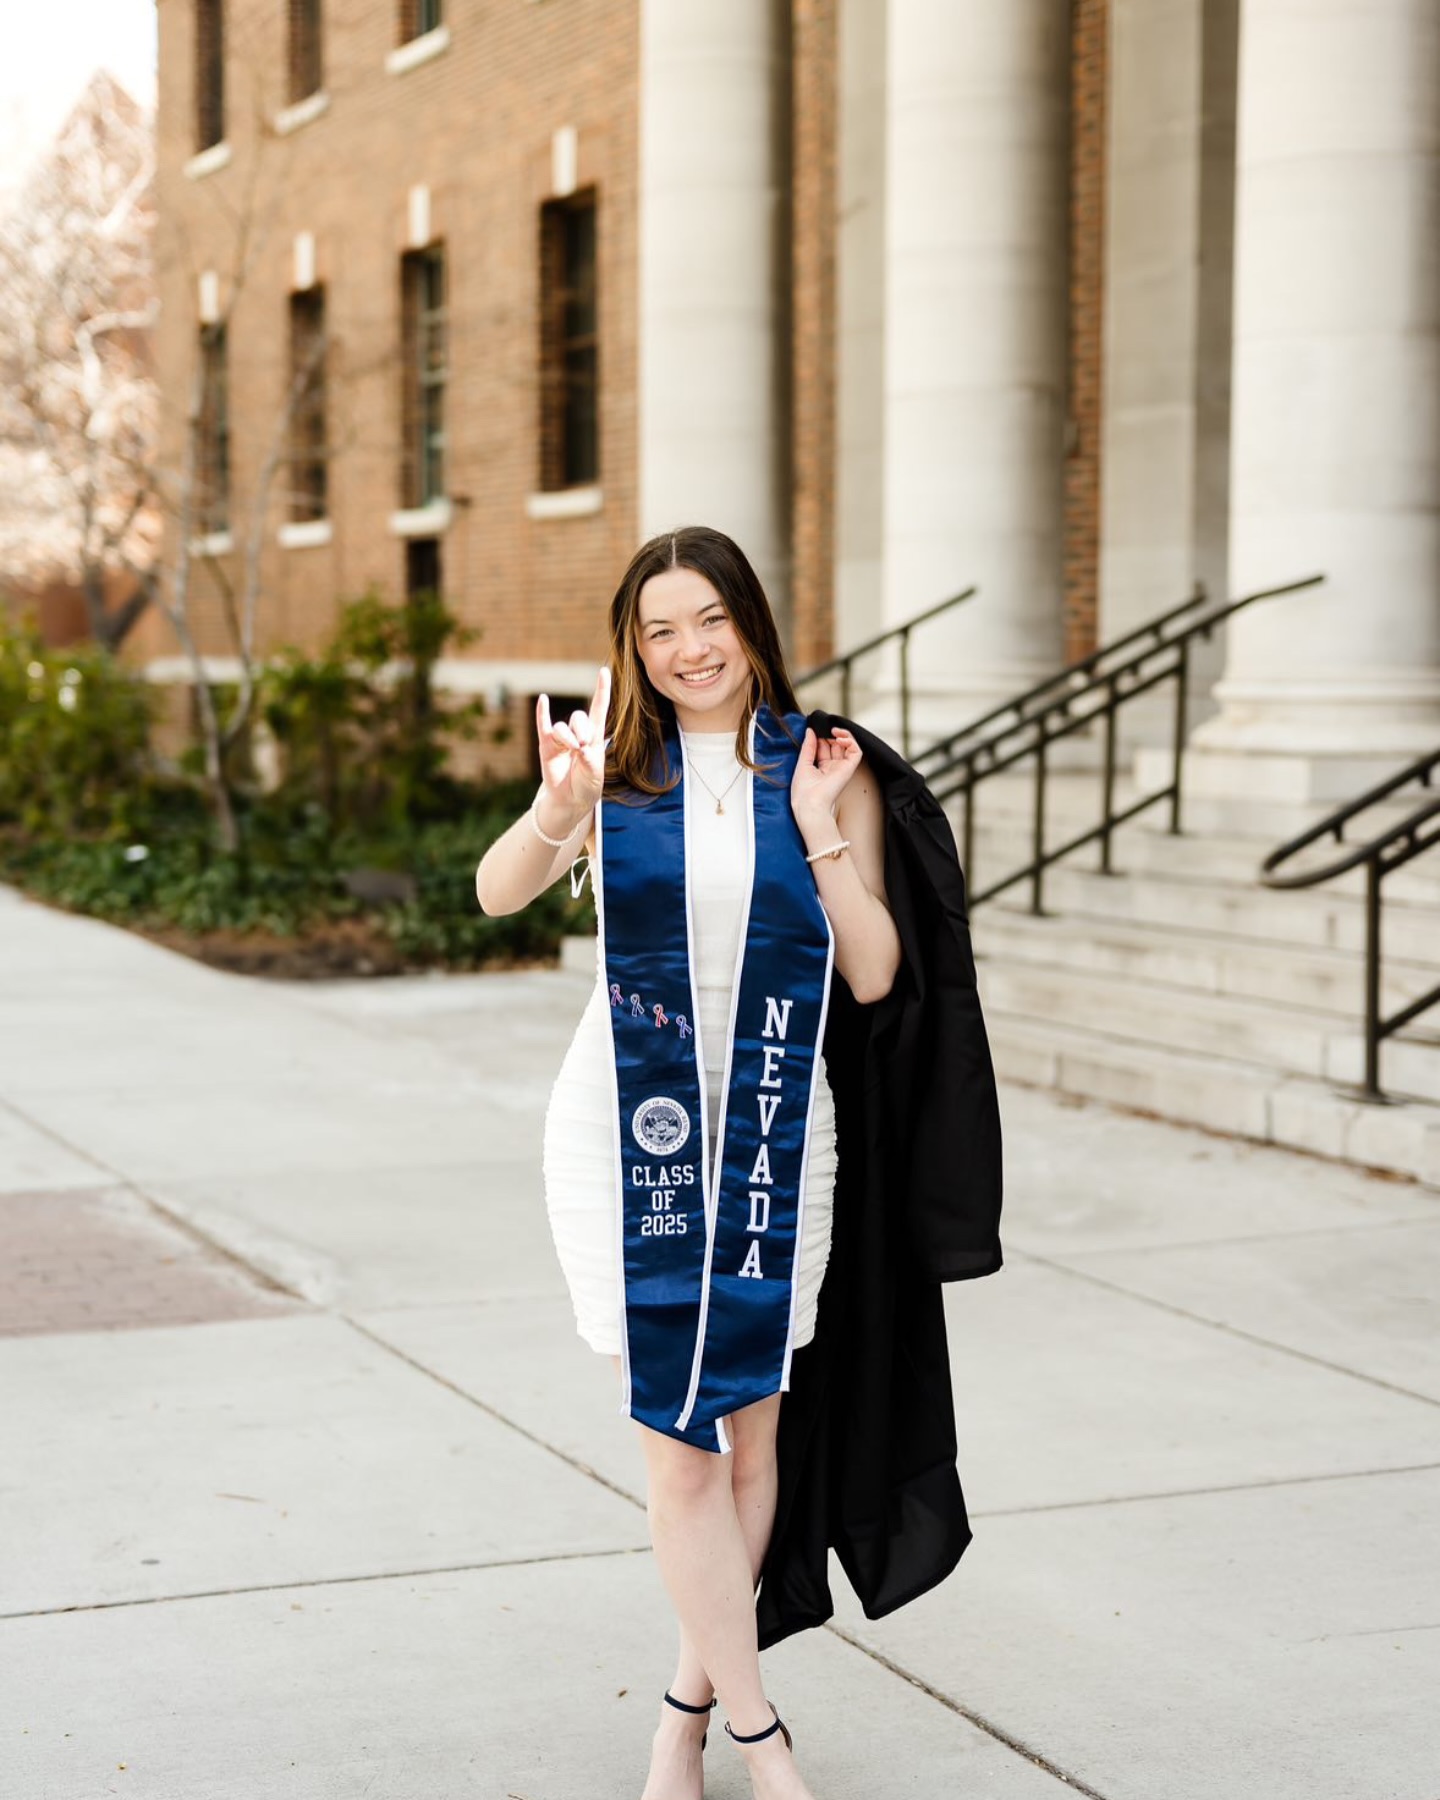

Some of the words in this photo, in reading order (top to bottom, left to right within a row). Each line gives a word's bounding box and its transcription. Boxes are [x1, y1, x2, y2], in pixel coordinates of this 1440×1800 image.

[738, 997, 793, 1279] NEVADA
[632, 1165, 694, 1187] CLASS
[651, 1190, 676, 1211] OF
[641, 1214, 688, 1236] 2025
